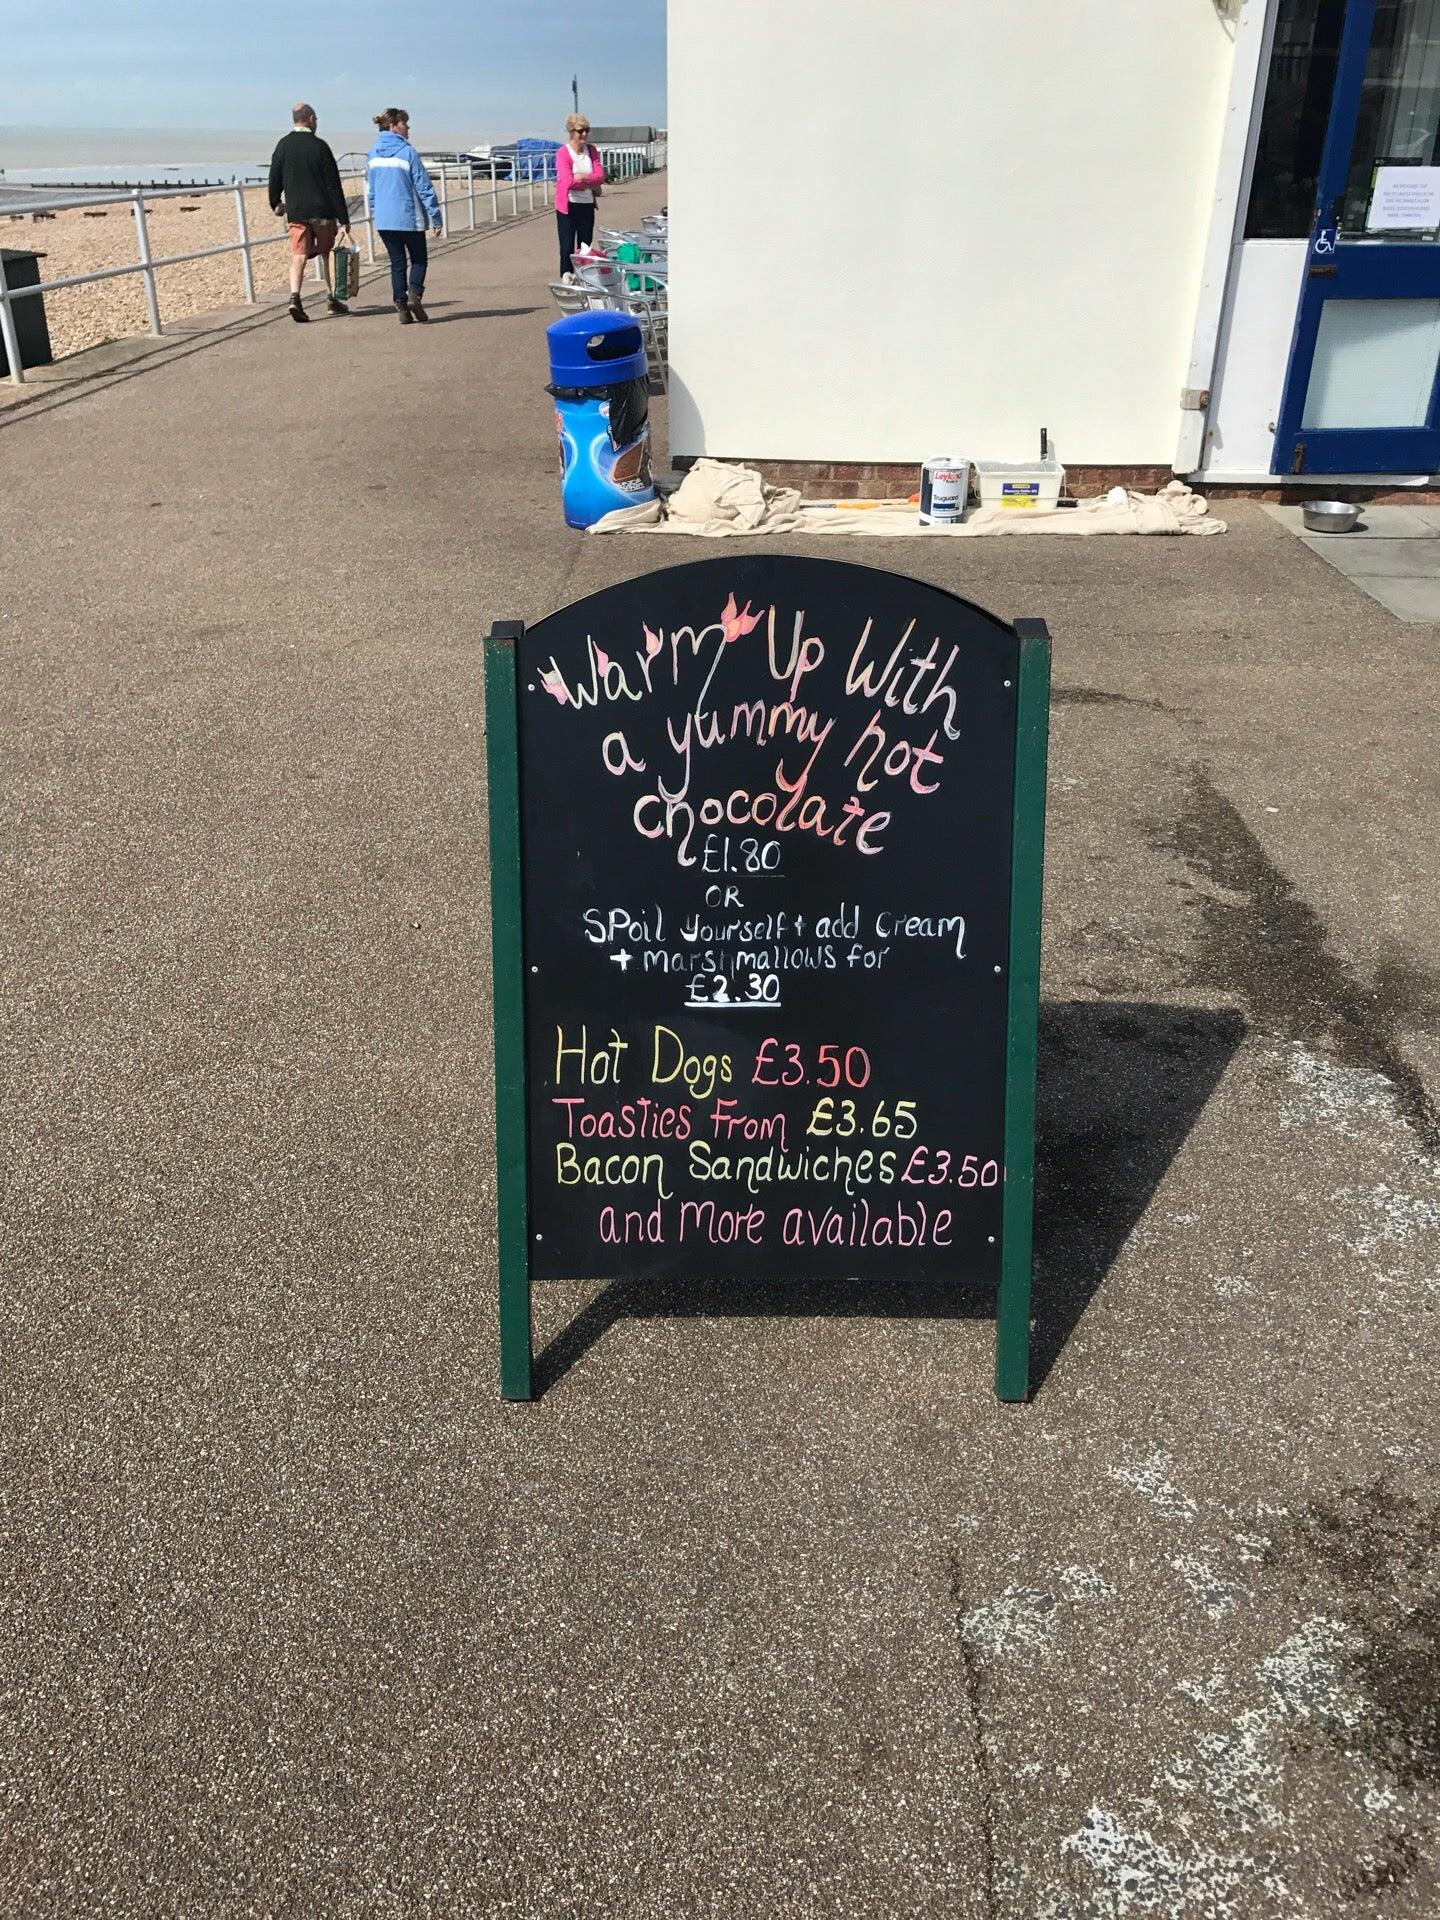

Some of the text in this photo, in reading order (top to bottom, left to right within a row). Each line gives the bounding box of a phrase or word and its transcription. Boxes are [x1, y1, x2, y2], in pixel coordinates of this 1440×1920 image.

[546, 605, 961, 740] Warm Up With
[602, 699, 944, 803] a yummy hot
[701, 833, 781, 873] £1.80
[705, 884, 744, 907] OR
[815, 902, 860, 939] add
[846, 943, 890, 969] for
[685, 973, 780, 1003] £2.30
[556, 1025, 871, 1099] Hot Dogs £3.50
[551, 1096, 917, 1153] Toasties From £3.65
[556, 1140, 998, 1200] Bacon Sandwiches £3.50
[600, 1198, 953, 1247] and More available
